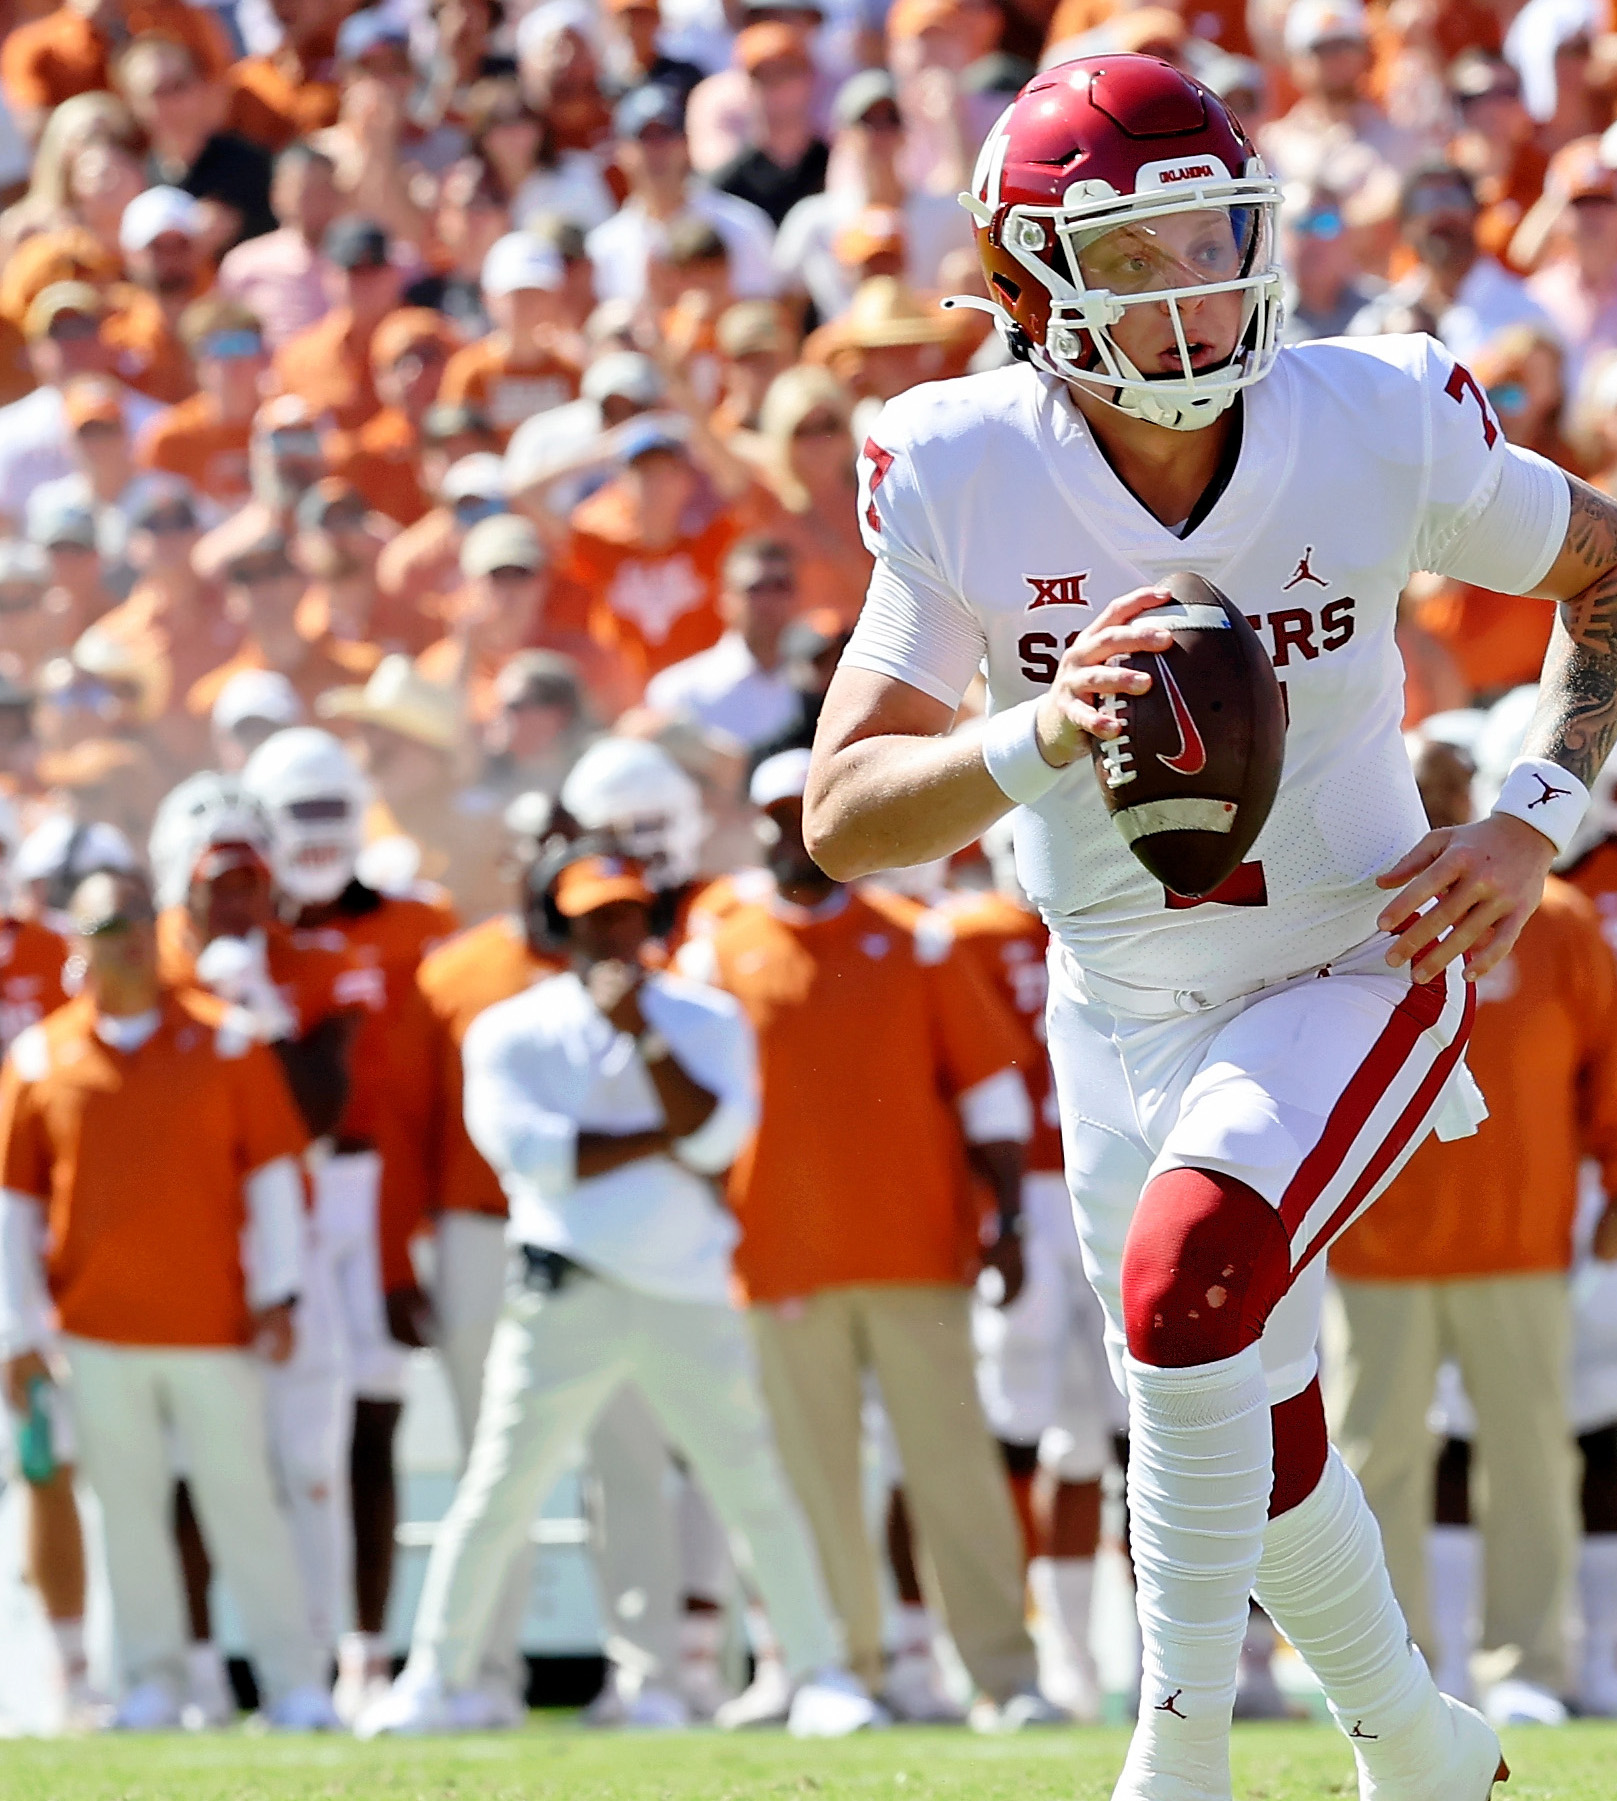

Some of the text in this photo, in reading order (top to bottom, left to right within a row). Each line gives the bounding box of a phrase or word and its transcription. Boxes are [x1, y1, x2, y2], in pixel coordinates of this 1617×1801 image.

[1159, 165, 1214, 183] OKLAHOMA
[1444, 362, 1497, 451] 7
[1025, 573, 1090, 611] XII
